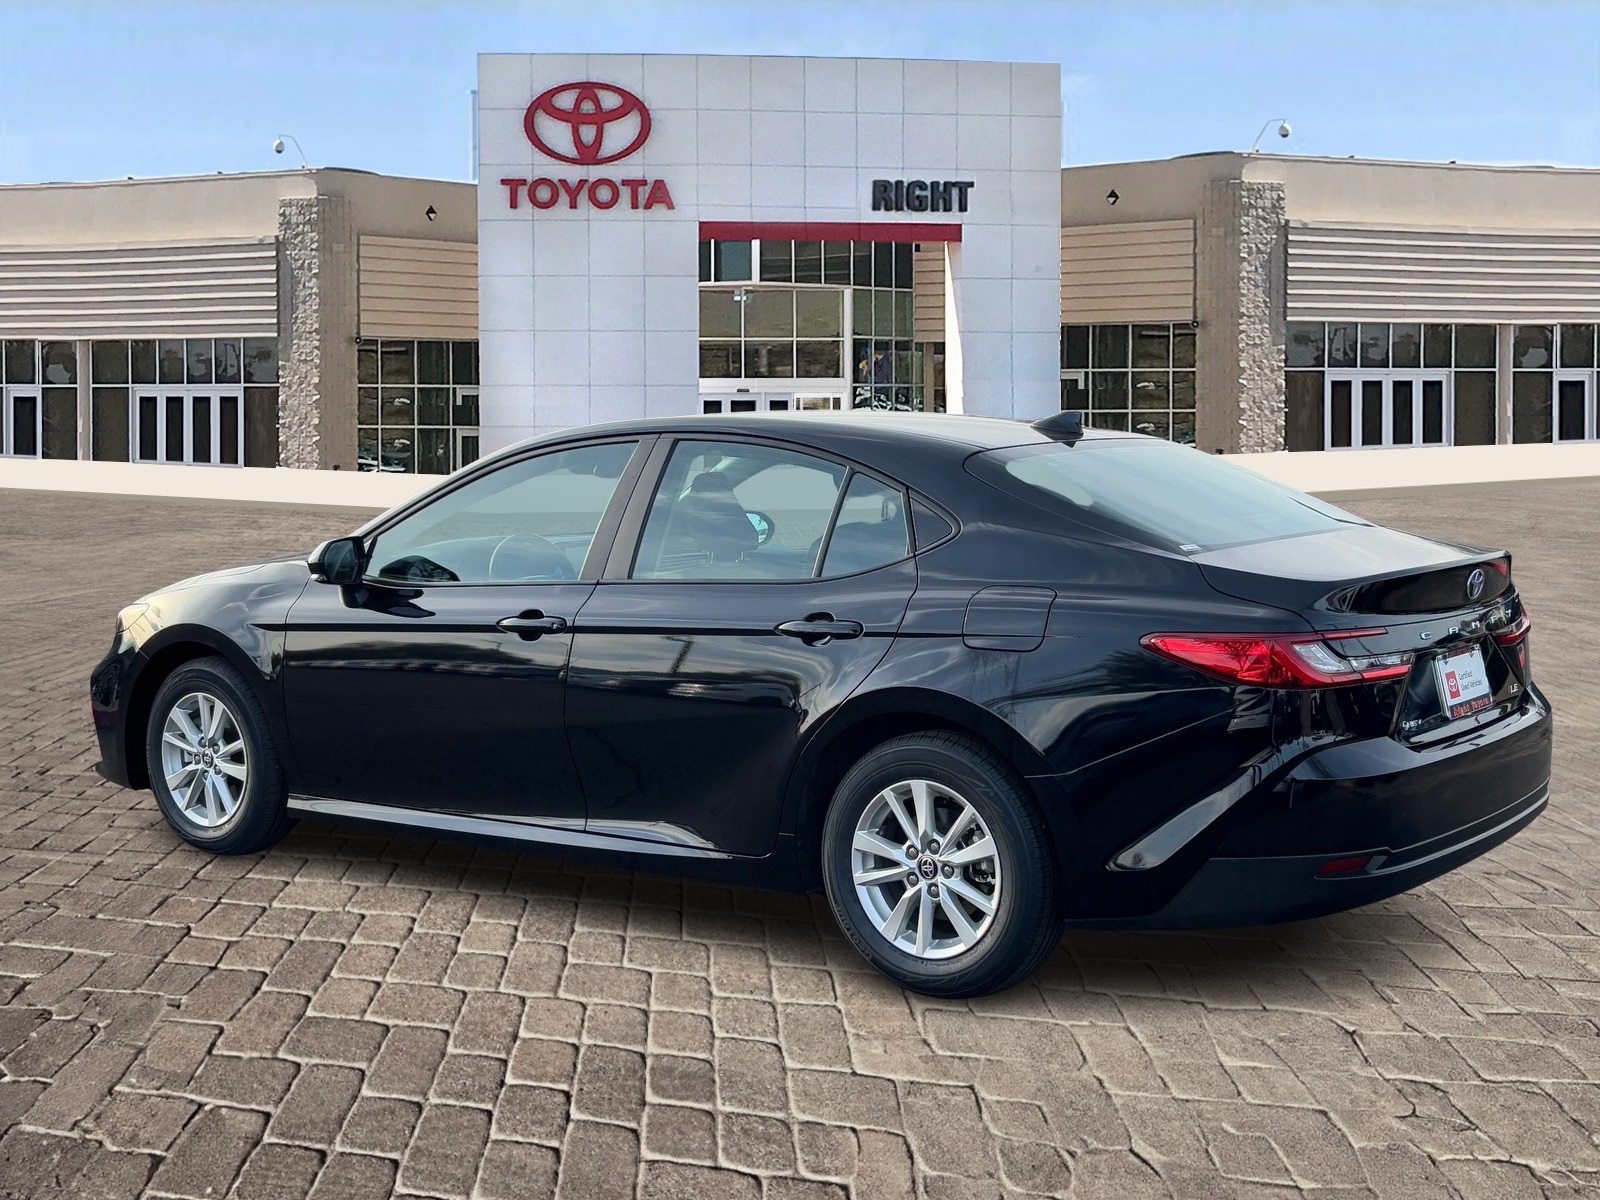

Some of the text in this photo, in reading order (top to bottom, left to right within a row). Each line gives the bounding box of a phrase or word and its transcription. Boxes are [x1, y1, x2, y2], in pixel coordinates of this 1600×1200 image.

[500, 178, 675, 210] TOYOTA
[871, 179, 975, 213] RIGHT
[1509, 684, 1518, 694] LE
